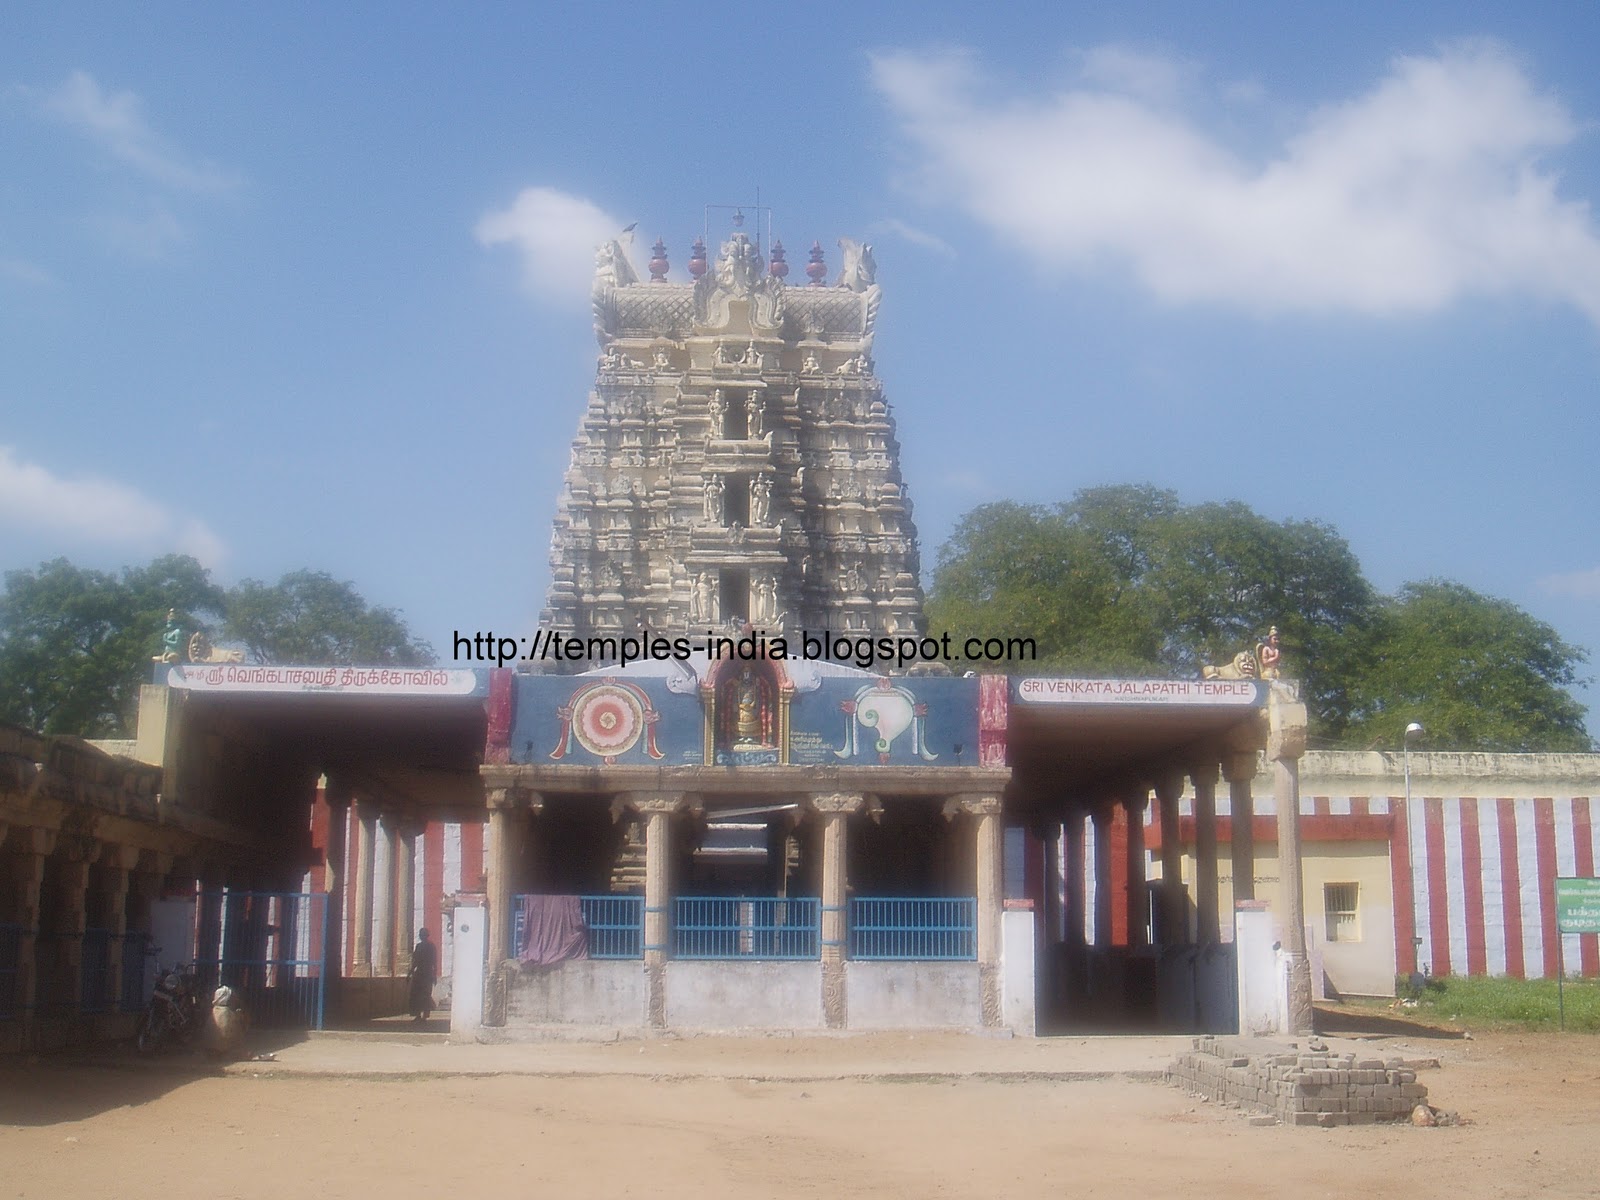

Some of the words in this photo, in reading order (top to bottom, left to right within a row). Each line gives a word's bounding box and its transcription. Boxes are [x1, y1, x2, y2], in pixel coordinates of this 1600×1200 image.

[1022, 680, 1044, 693] SRI
[1048, 681, 1190, 695] VENKATAJALAPATHI
[1195, 681, 1250, 696] TEMPLE
